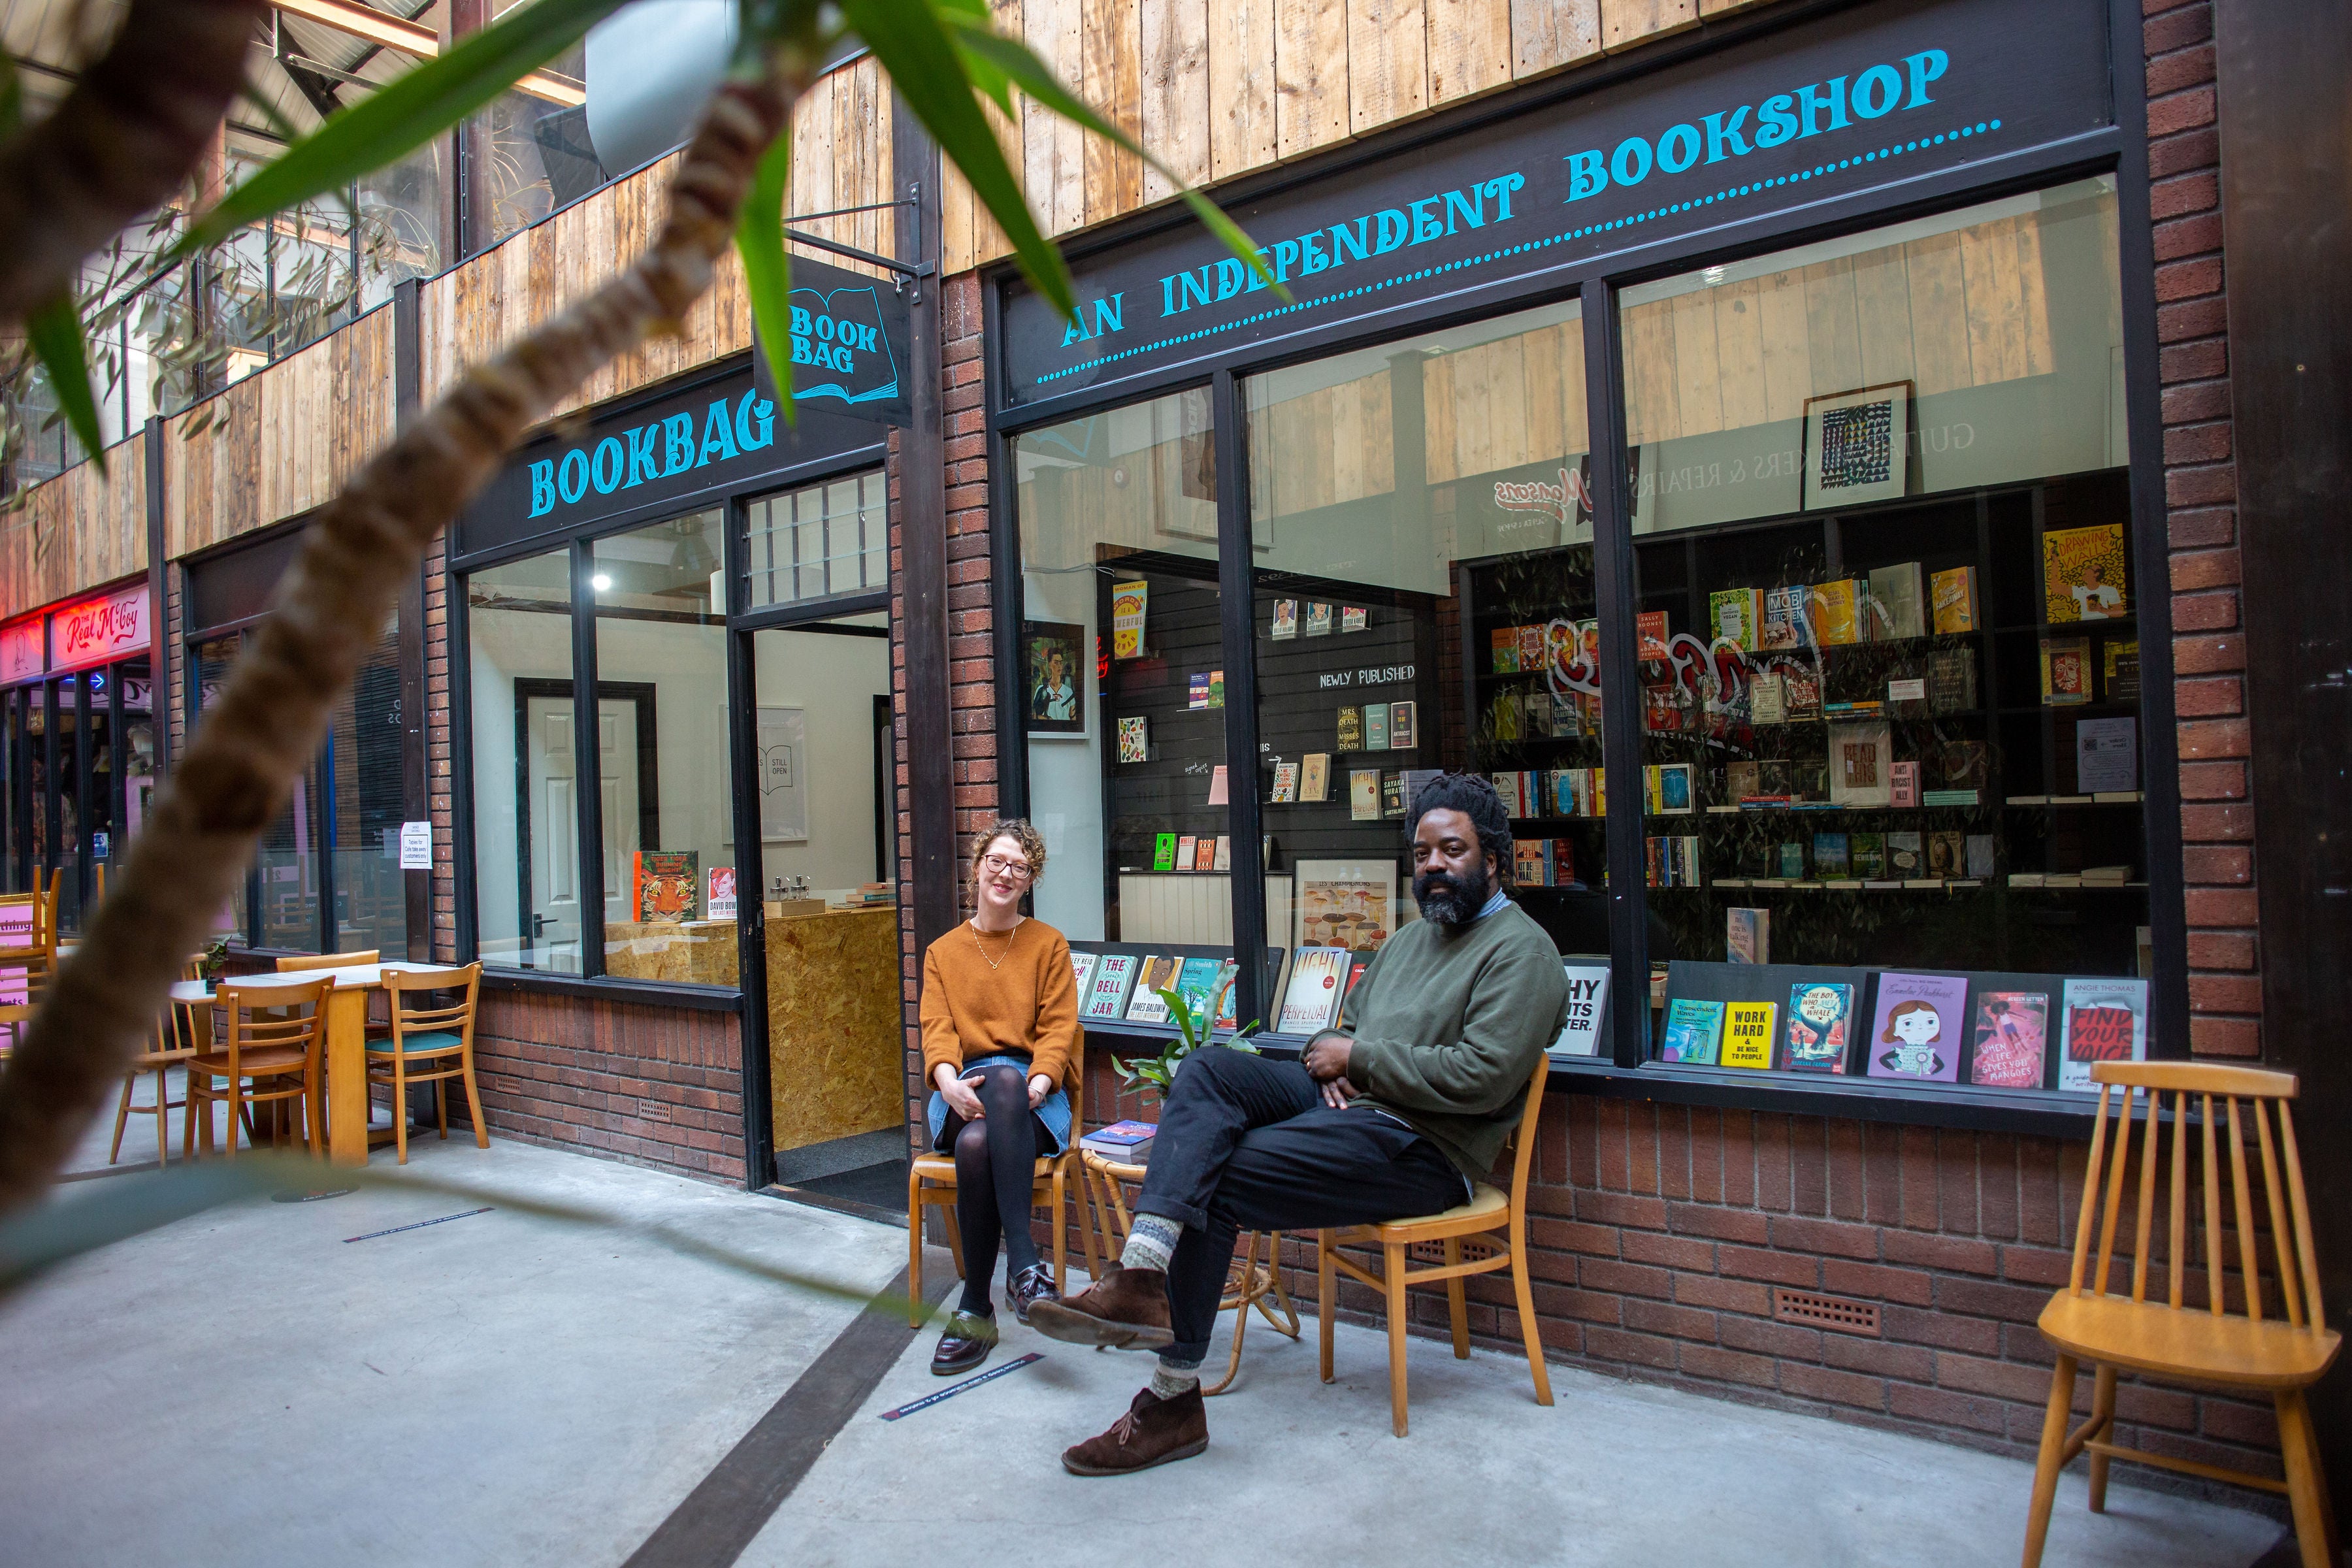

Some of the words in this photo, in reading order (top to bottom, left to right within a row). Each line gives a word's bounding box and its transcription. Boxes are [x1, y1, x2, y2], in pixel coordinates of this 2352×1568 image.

[1059, 292, 1125, 349] AN
[1158, 172, 1526, 318] INDEPENDENT
[1562, 49, 1950, 204] BOOKSHOP
[788, 305, 877, 353] BOOK
[789, 334, 855, 376] BAG
[527, 388, 776, 519] BOOKBAG
[2059, 531, 2109, 556] DRAWING
[2062, 543, 2109, 568] WALLS
[1769, 594, 1799, 608] MOB
[1936, 590, 1965, 610] FAKEAWAY
[1114, 616, 1143, 629] WERFUL
[1768, 610, 1803, 623] KITCHEN
[67, 611, 95, 653] Real
[1320, 670, 1352, 688] NEWLY
[1358, 665, 1416, 685] PUBLISHED
[1185, 762, 1198, 774] signed
[1195, 762, 1207, 774] copies
[1351, 772, 1374, 789] LIGHT
[1384, 779, 1405, 789] SAYAKA
[1891, 777, 1910, 787] RACIST
[1384, 786, 1405, 795] MURATA
[1896, 790, 1908, 800] ALLY
[1180, 836, 1195, 845] WHITES
[1526, 861, 1533, 870] DE
[1518, 871, 1533, 881] WAAL
[710, 901, 725, 910] DAVID
[725, 901, 736, 910] BOW
[1730, 933, 1748, 943] talking
[1105, 959, 1126, 972] THE
[1293, 951, 1340, 978] LIGHT
[1184, 968, 1203, 976] Spring
[1096, 980, 1120, 994] BELL
[1569, 979, 1601, 1000] HY
[1092, 1002, 1114, 1015] JAR
[1131, 1002, 1147, 1012] JAMES
[1145, 1003, 1166, 1013] BALDWIN
[1282, 1004, 1328, 1020] PERPETUAL
[1678, 1004, 1718, 1013] Transcendent
[1735, 1011, 1767, 1023] WORK
[2073, 1008, 2133, 1026] FIND
[1733, 1024, 1764, 1036] HARD
[2073, 1026, 2133, 1044] YOUR
[1981, 1043, 2007, 1055] WHEN
[1991, 1053, 2012, 1062] LIFE
[1982, 1062, 2008, 1074] GIVES
[2008, 1059, 2028, 1068] YOU
[1990, 1067, 2032, 1081] MANGOES
[2071, 1074, 2090, 1084] guide
[2076, 1082, 2099, 1090] writing
